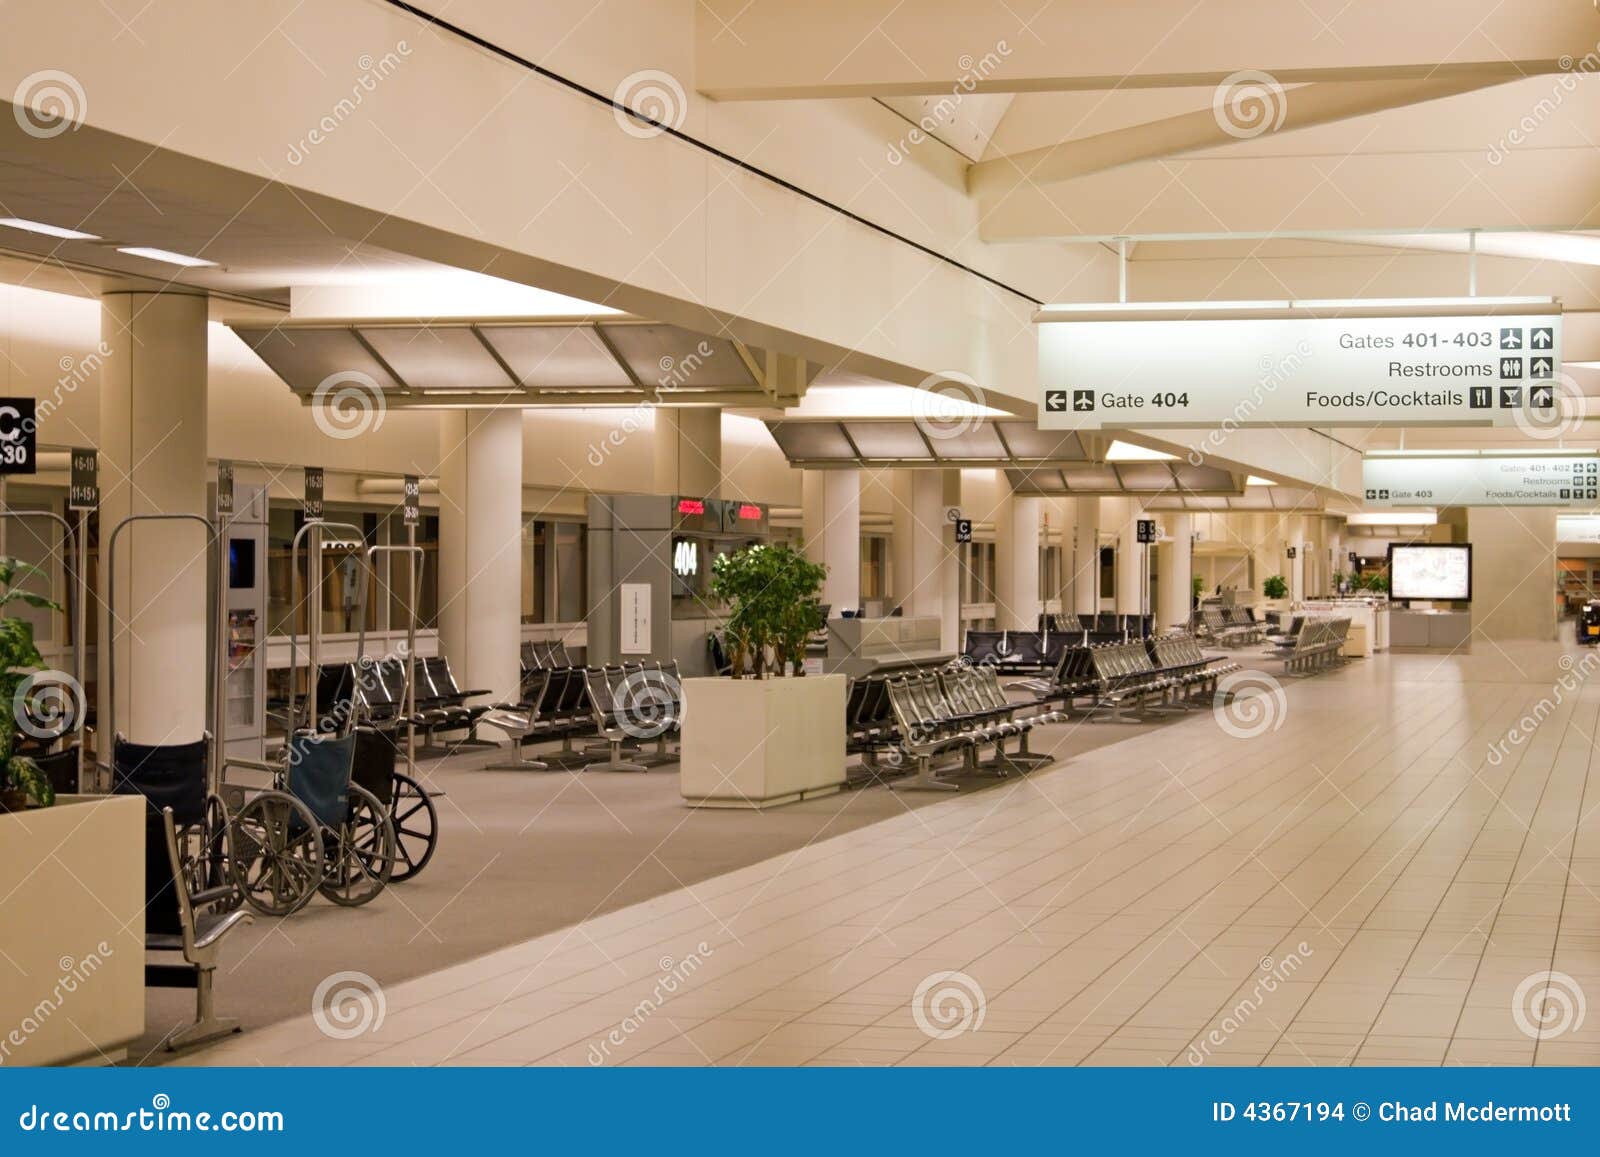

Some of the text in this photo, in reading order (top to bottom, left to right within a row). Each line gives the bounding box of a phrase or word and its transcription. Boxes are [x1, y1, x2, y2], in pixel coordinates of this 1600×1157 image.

[1339, 332, 1395, 349] Gates
[1389, 360, 1493, 377] Restrooms
[1101, 392, 1190, 409] Gate 404
[1306, 389, 1463, 407] Foods/Cocktails
[0, 406, 20, 441] C
[79, 457, 94, 471] 6-10
[1500, 464, 1526, 474] Gates
[1523, 477, 1571, 486] Restrooms
[72, 486, 92, 501] 11-15
[1391, 490, 1433, 499] Gate 403
[1485, 490, 1557, 499] Foods/Cocktails
[960, 522, 968, 533] C
[1139, 522, 1146, 534] B
[673, 541, 698, 576] 404
